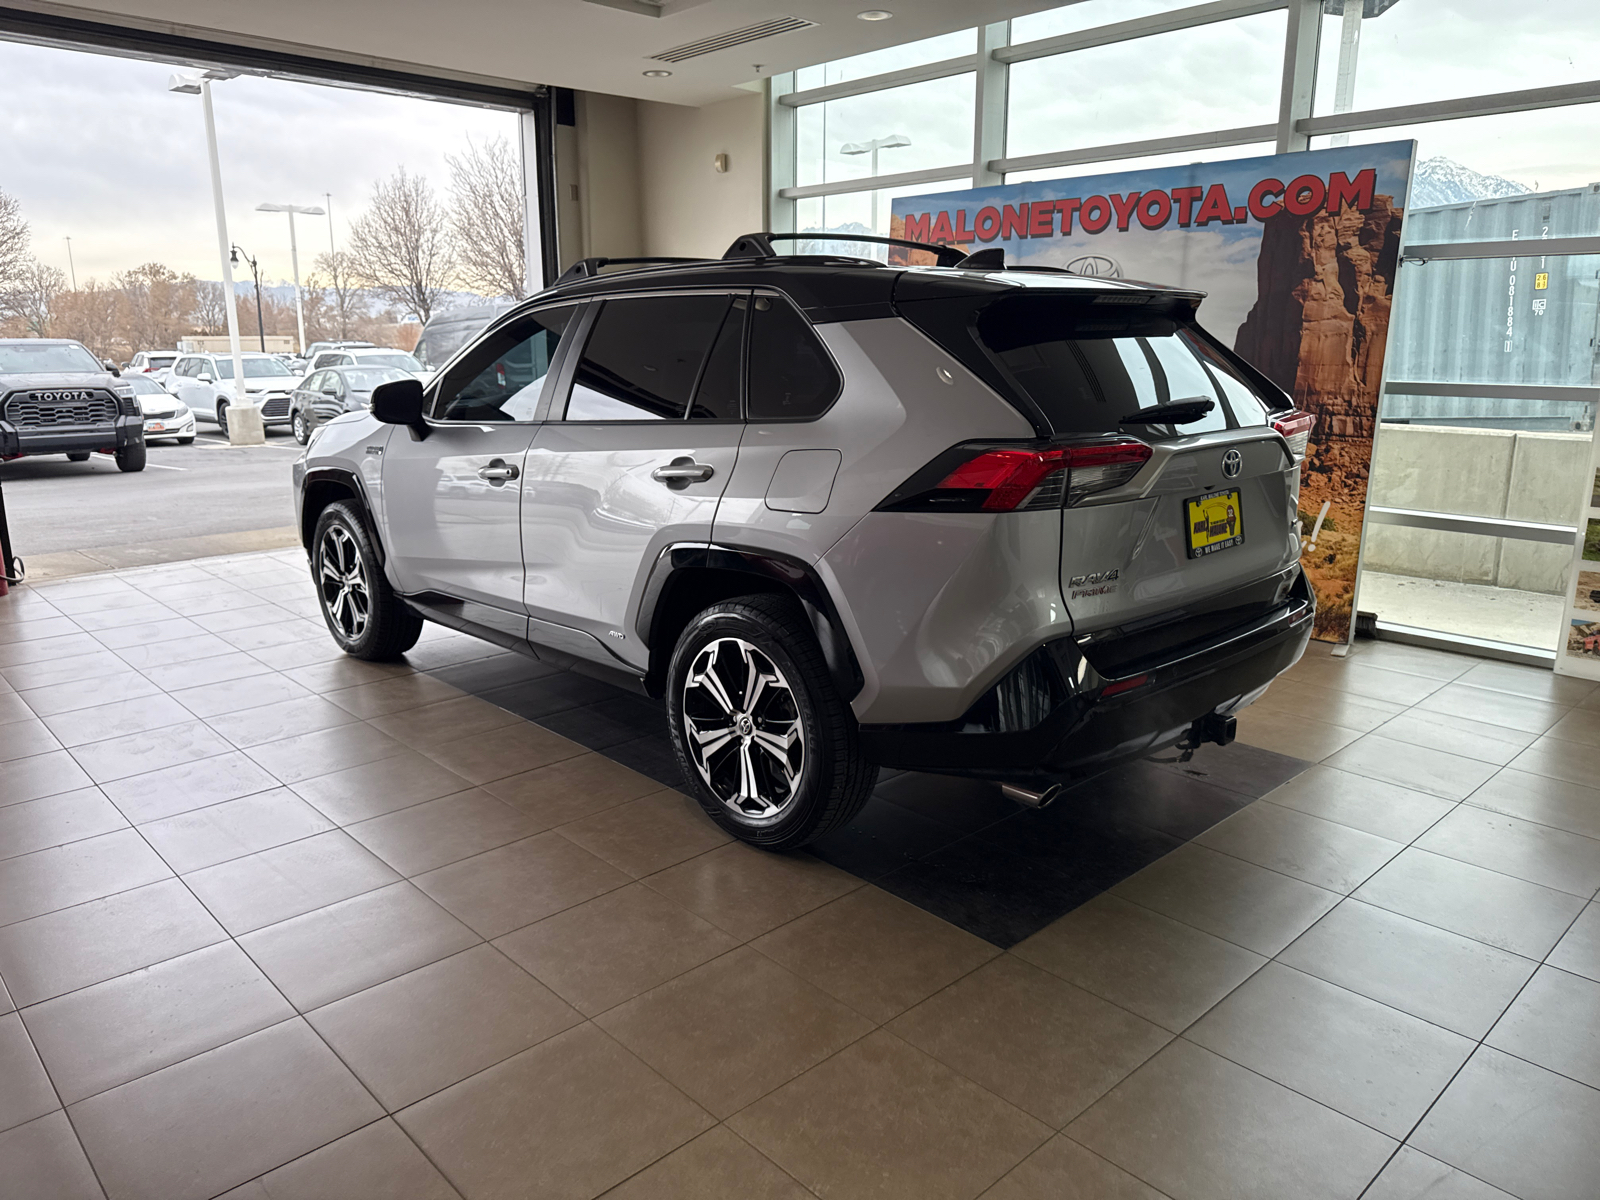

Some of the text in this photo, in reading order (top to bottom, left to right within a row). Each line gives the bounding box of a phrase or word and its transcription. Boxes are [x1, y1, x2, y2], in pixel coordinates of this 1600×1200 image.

[904, 168, 1377, 245] MALONETOYOTA.COM
[35, 391, 88, 402] TOYOTA
[1068, 568, 1119, 588] RAV4
